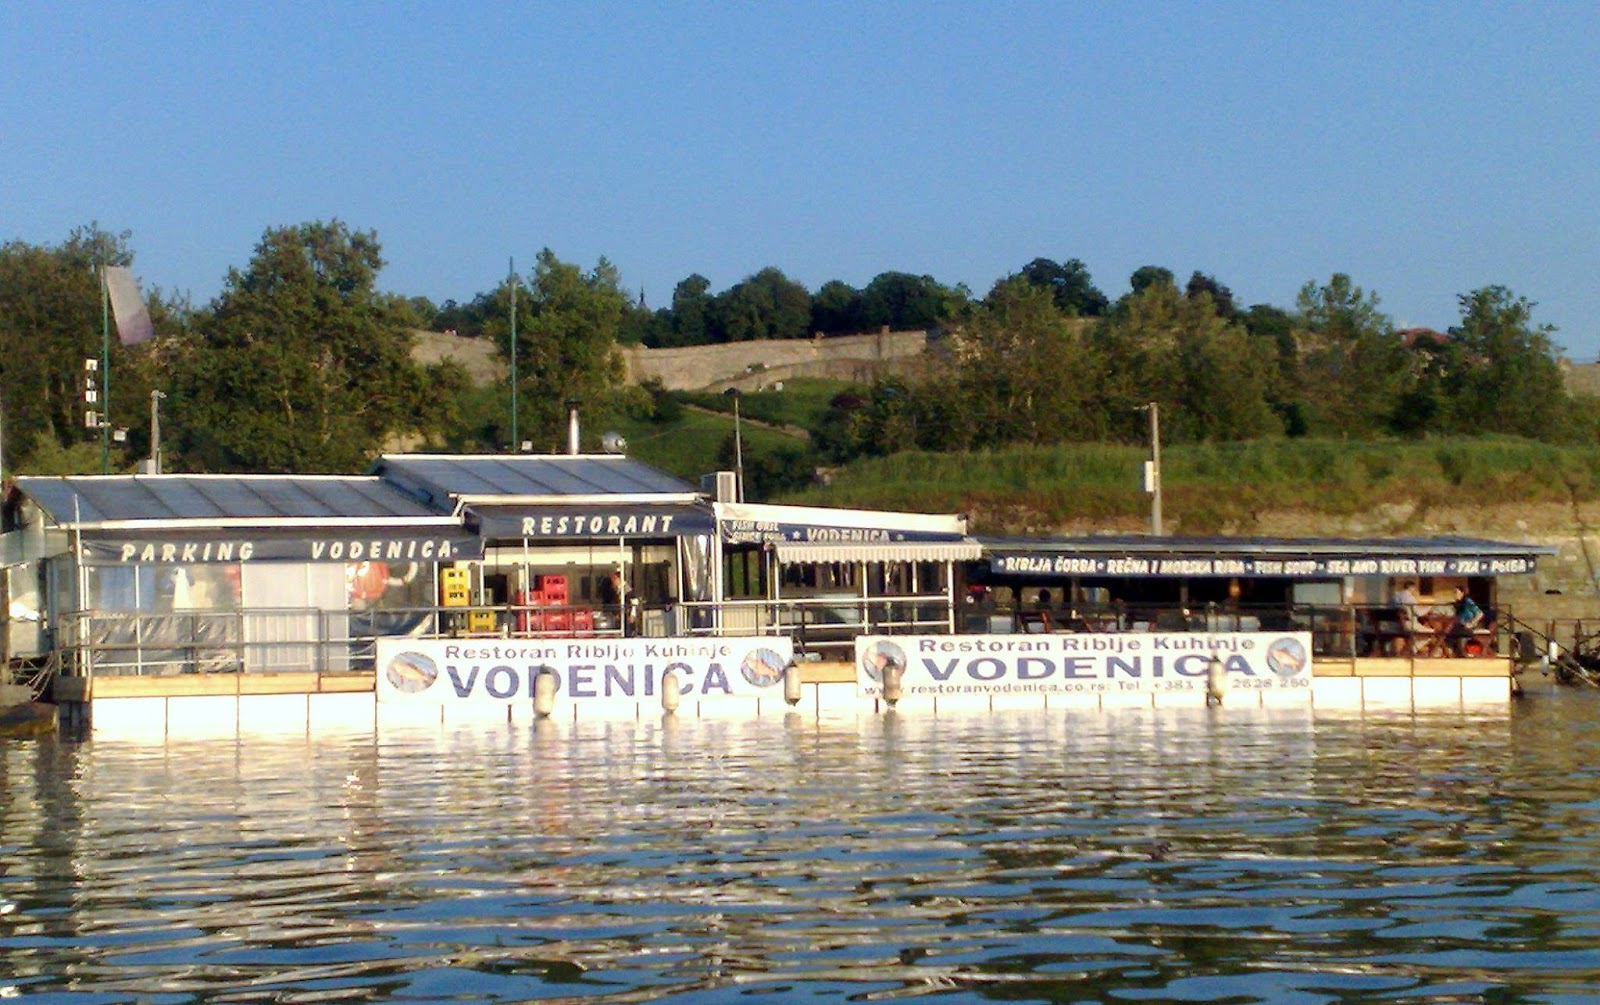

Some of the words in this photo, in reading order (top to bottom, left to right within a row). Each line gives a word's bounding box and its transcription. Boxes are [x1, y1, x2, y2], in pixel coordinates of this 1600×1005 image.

[522, 515, 673, 535] RESTORANT
[806, 528, 890, 542] VODENICA
[121, 542, 255, 562] PARKING
[311, 540, 452, 560] VODENICA
[1006, 557, 1052, 571] RIBLJA
[1055, 556, 1097, 573] ČORBA
[1107, 557, 1148, 573] REČNA
[1151, 559, 1159, 574] I
[1160, 559, 1212, 574] MORSKA
[1214, 560, 1245, 574] RIBA
[1327, 560, 1351, 574] SEA
[1352, 560, 1378, 574] AND
[1381, 560, 1417, 574] RIVER
[1419, 560, 1447, 574] FISH
[445, 644, 558, 660] Restoran
[919, 639, 1050, 652] Restoran
[1062, 637, 1141, 653] Riblje
[1154, 636, 1256, 653] Kuhinje
[921, 655, 1257, 681] VODENICA
[446, 662, 734, 699] VODENICA
